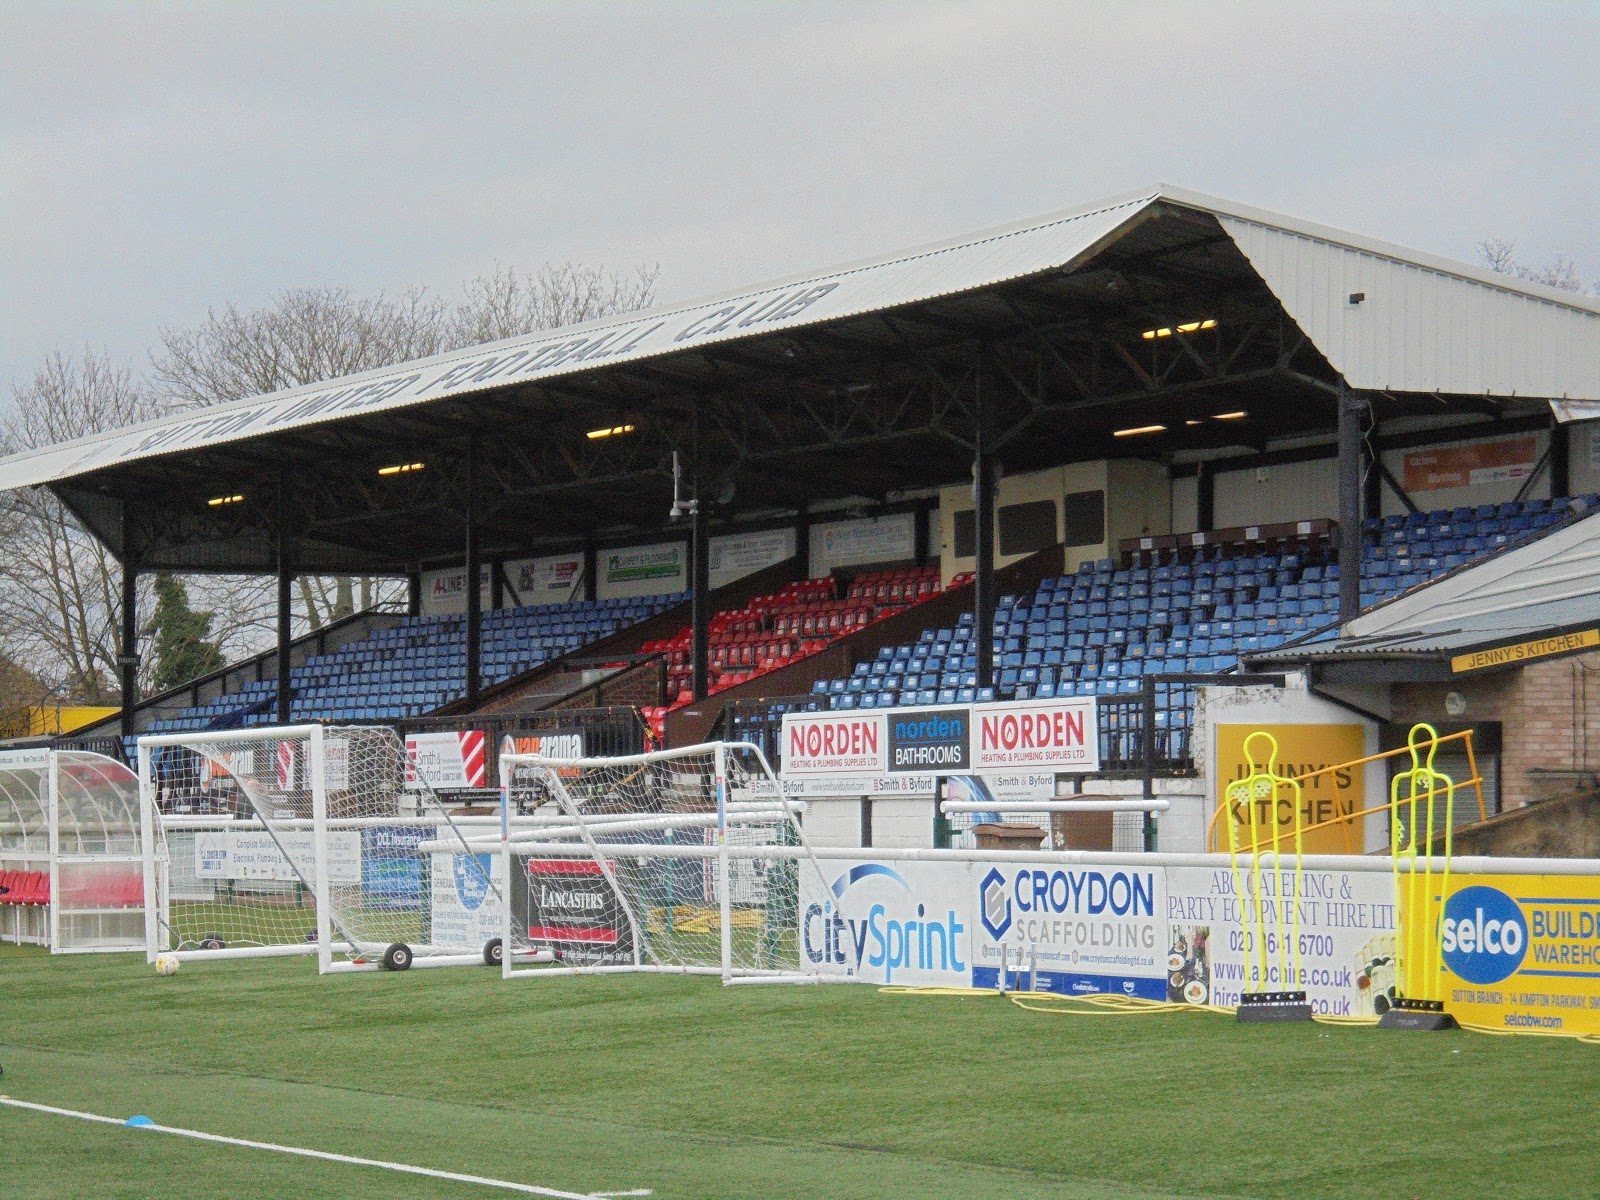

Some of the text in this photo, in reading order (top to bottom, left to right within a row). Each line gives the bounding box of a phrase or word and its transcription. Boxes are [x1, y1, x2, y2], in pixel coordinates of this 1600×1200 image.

[266, 373, 422, 426] UNITED
[415, 320, 665, 396] FOOTBALL
[673, 282, 840, 342] CLUB
[1469, 634, 1583, 668] JENNY'S KITCHEN
[790, 721, 878, 757] NORDEN
[896, 714, 962, 739] norden
[981, 710, 1084, 750] NORDEN
[418, 750, 436, 765] Smith
[790, 760, 811, 769] HEATING
[818, 758, 843, 768] PLUMBING
[844, 758, 866, 767] SUPPLIES
[867, 757, 878, 766] LTD
[896, 744, 961, 765] BATHROOMS
[981, 749, 1085, 763] HEATING & PLUMBING SUPPLIES LTD
[755, 779, 804, 795] Smith Byford
[879, 777, 932, 793] Smith & Byford
[997, 775, 1052, 787] Smith & Byford
[1230, 798, 1354, 825] KITCHEN
[541, 885, 604, 909] LANCASTERS
[1014, 869, 1154, 916] CROYDON
[1340, 874, 1353, 899] &
[1168, 896, 1218, 920] PARTY
[1223, 898, 1319, 926] EQUPMENT
[1326, 902, 1368, 928] HIRE
[1532, 910, 1600, 939] BUILD
[803, 900, 965, 983] CitySprint
[1016, 919, 1155, 949] SCAFFOLDING
[1229, 930, 1253, 952] 020
[1299, 934, 1334, 957] 6700
[1442, 907, 1522, 955] selco
[1453, 989, 1475, 1003] SUTTON
[1477, 990, 1503, 1005] BRANCH
[1504, 1011, 1562, 1029] selcobw.com
